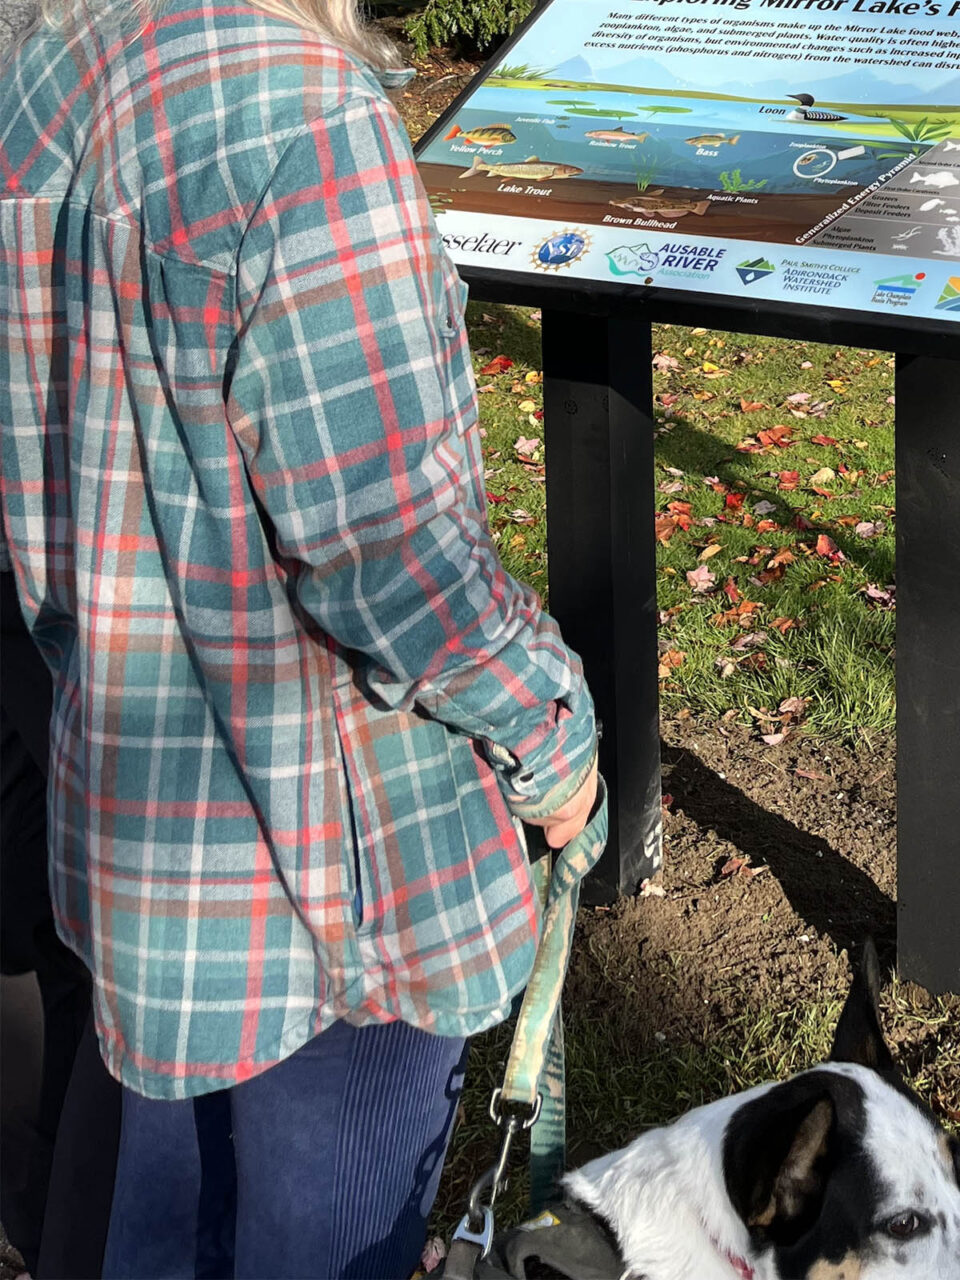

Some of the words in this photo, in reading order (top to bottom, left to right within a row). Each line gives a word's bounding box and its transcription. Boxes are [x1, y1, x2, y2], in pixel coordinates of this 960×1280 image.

[609, 12, 633, 21] Many
[634, 13, 680, 23] different
[680, 16, 708, 25] types
[709, 17, 723, 25] of
[722, 19, 775, 28] organisms
[776, 21, 807, 29] make
[807, 24, 823, 32] up
[823, 23, 843, 31] the
[843, 24, 879, 33] Mirror
[879, 26, 907, 35] Lake
[908, 27, 935, 37] food
[936, 30, 960, 39] web,
[599, 22, 662, 32] zooplankton,
[663, 24, 694, 34] algae,
[696, 27, 718, 35] and
[718, 28, 777, 39] submerged
[775, 31, 812, 40] plants.
[816, 33, 847, 42] Water
[848, 36, 886, 46] quality
[887, 37, 898, 45] is
[899, 38, 930, 47] often
[591, 30, 633, 41] diversity
[647, 35, 702, 45] organisms,
[704, 36, 724, 45] but
[724, 39, 802, 50] environmental
[801, 43, 846, 53] changes
[847, 46, 874, 54] such
[889, 47, 946, 58] increased
[617, 42, 664, 52] nutrients
[665, 45, 729, 56] (phosphorus
[730, 49, 753, 57] and
[752, 50, 803, 62] nitrogen)
[803, 53, 831, 62] from
[832, 55, 852, 63] the
[853, 57, 912, 67] watershed
[758, 105, 787, 115] Loon
[449, 144, 477, 153] Yellow
[476, 146, 504, 156] Perch
[588, 140, 618, 148] Rainbow
[618, 142, 637, 150] Trout
[695, 147, 719, 157] Bass
[812, 176, 859, 186] Phytoplankton
[496, 183, 523, 194] Lake
[524, 185, 553, 196] Trout
[706, 193, 735, 202] Aquatic
[734, 196, 759, 204] Plants
[795, 202, 850, 244] Generalized
[847, 180, 881, 205] Energy
[878, 153, 917, 182] Pyramid
[871, 194, 899, 202] Grazers
[861, 200, 882, 208] Filter
[881, 202, 911, 211] Feeders
[854, 207, 883, 215] Deposit
[882, 209, 911, 218] Feeders
[602, 214, 634, 225] Brown
[633, 217, 678, 229] Bullhead
[440, 231, 524, 257] sselaer
[821, 232, 875, 243] Phytoplankton
[658, 243, 727, 259] AUSABLE
[811, 239, 853, 249] Submerged
[852, 243, 877, 251] Plants
[661, 254, 719, 272] RIVER
[657, 268, 712, 281] Association
[782, 267, 849, 282] ADIRONDACK
[783, 274, 842, 288] WATERSHED
[782, 282, 832, 295] INSTITUTE
